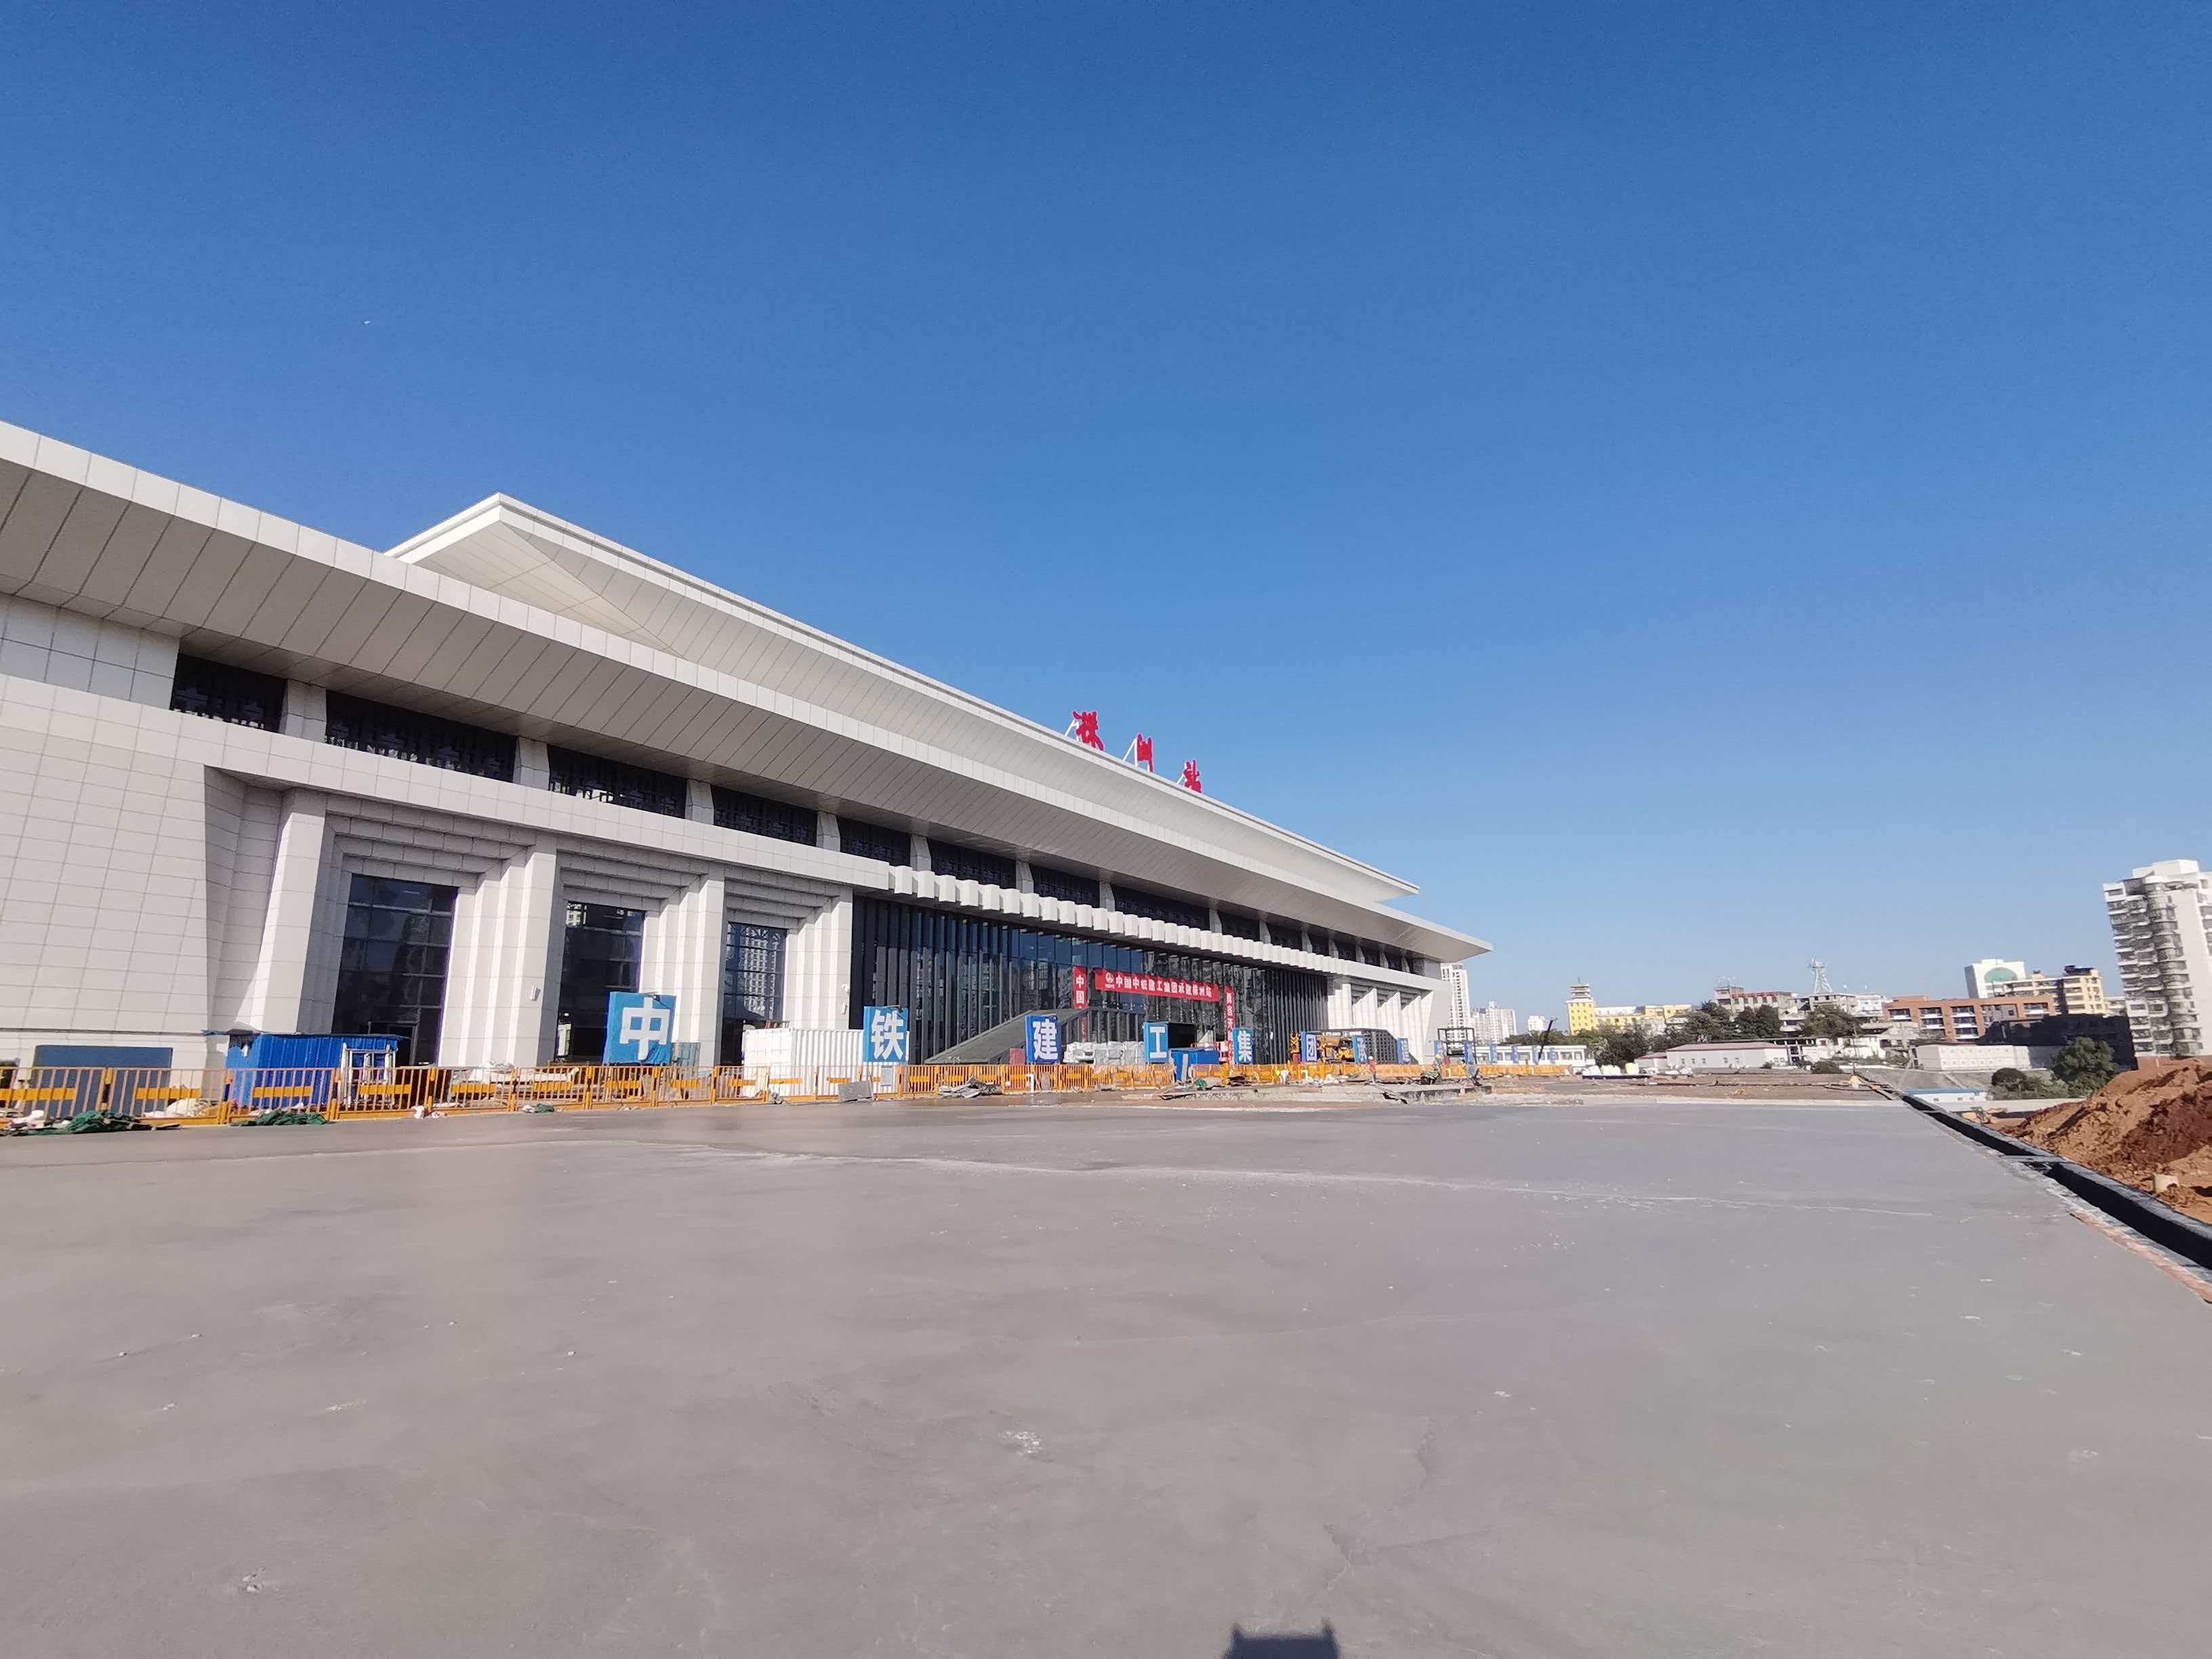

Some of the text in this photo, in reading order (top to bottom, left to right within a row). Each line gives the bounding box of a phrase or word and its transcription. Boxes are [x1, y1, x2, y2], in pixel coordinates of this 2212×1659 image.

[619, 998, 670, 1061] 中
[871, 1010, 905, 1061] 铁
[1032, 1019, 1059, 1061] 建
[1149, 1026, 1168, 1059] 工
[1237, 1029, 1253, 1062] 集
